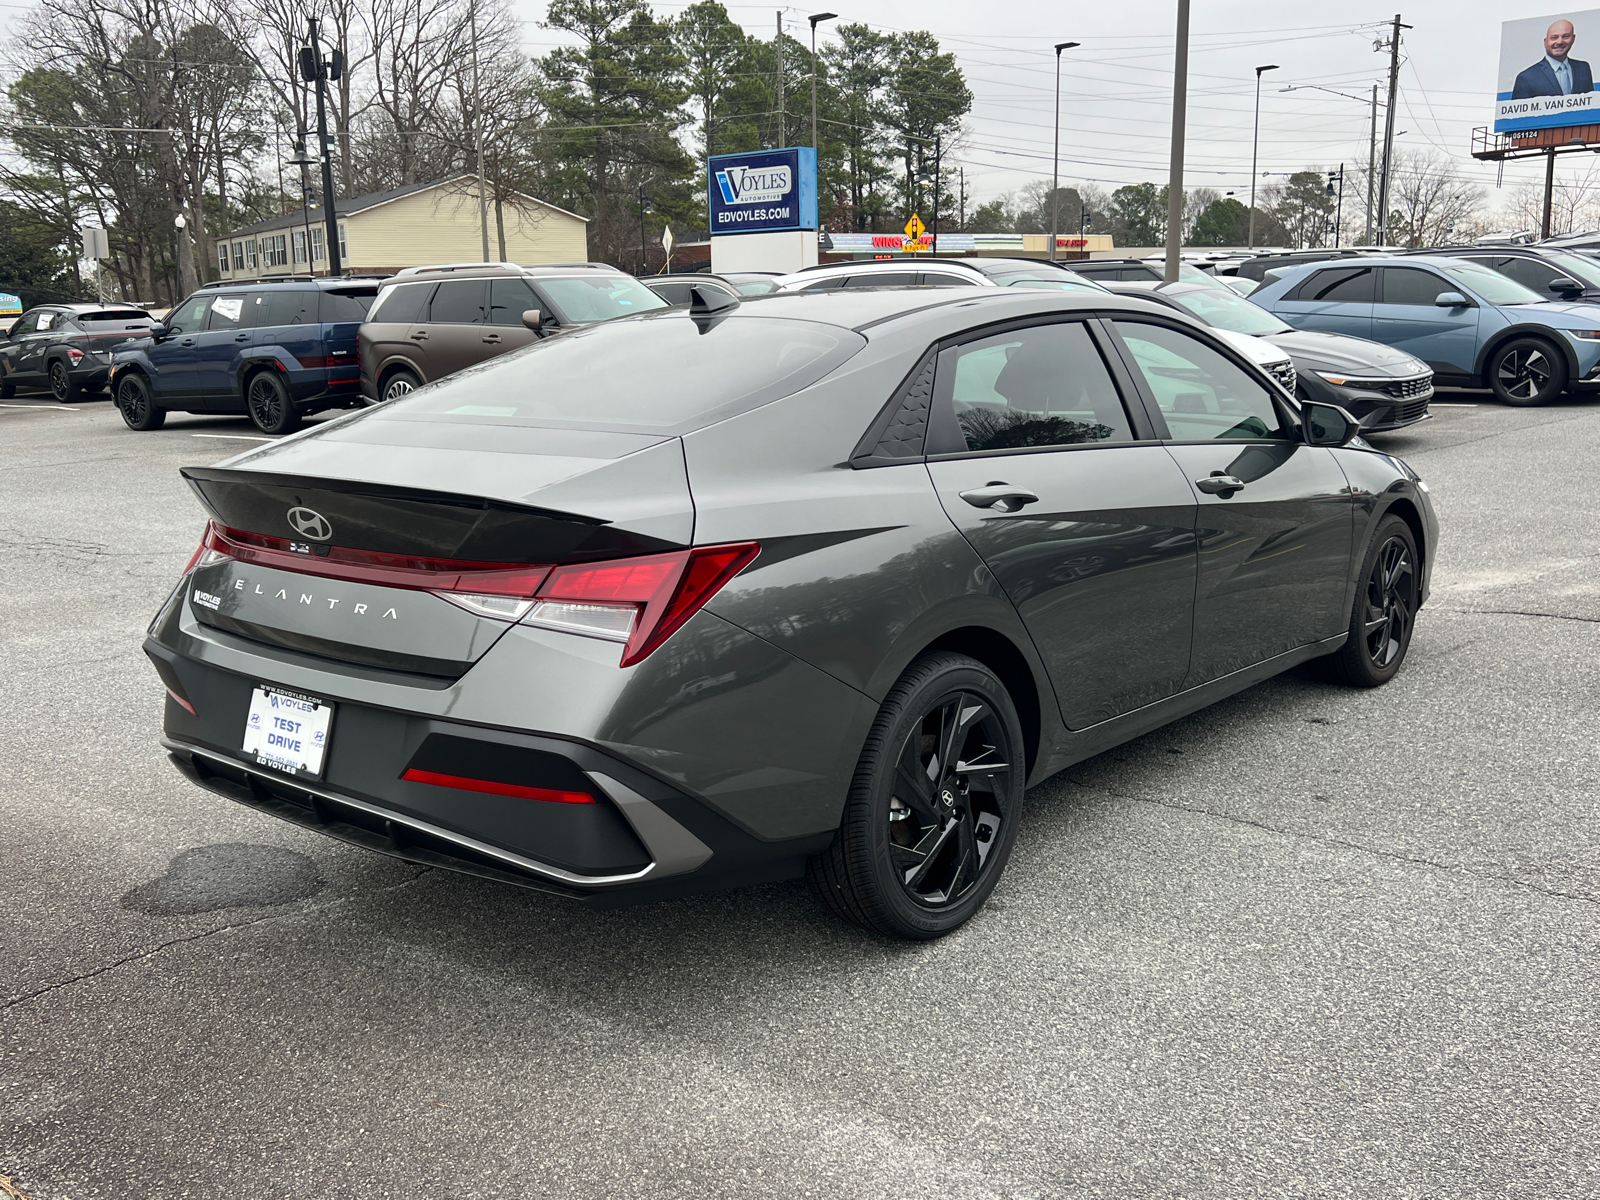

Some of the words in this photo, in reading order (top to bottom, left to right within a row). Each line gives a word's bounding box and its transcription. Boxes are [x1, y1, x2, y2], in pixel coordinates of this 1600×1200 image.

[1501, 104, 1528, 114] DAVID
[1531, 102, 1541, 111] M.
[1545, 100, 1564, 109] VAN
[1566, 97, 1592, 107] SANT
[726, 168, 787, 199] VOYLES
[740, 194, 780, 202] AUTOMOTIVE
[718, 207, 790, 223] EDVOYLES.COM
[872, 236, 902, 248] WING
[235, 579, 398, 620] ELANTRA
[280, 697, 313, 713] VOYLES
[274, 716, 302, 734] TEST
[267, 733, 302, 752] DRIVE
[256, 756, 266, 765] ED
[268, 760, 297, 775] VOYLES
